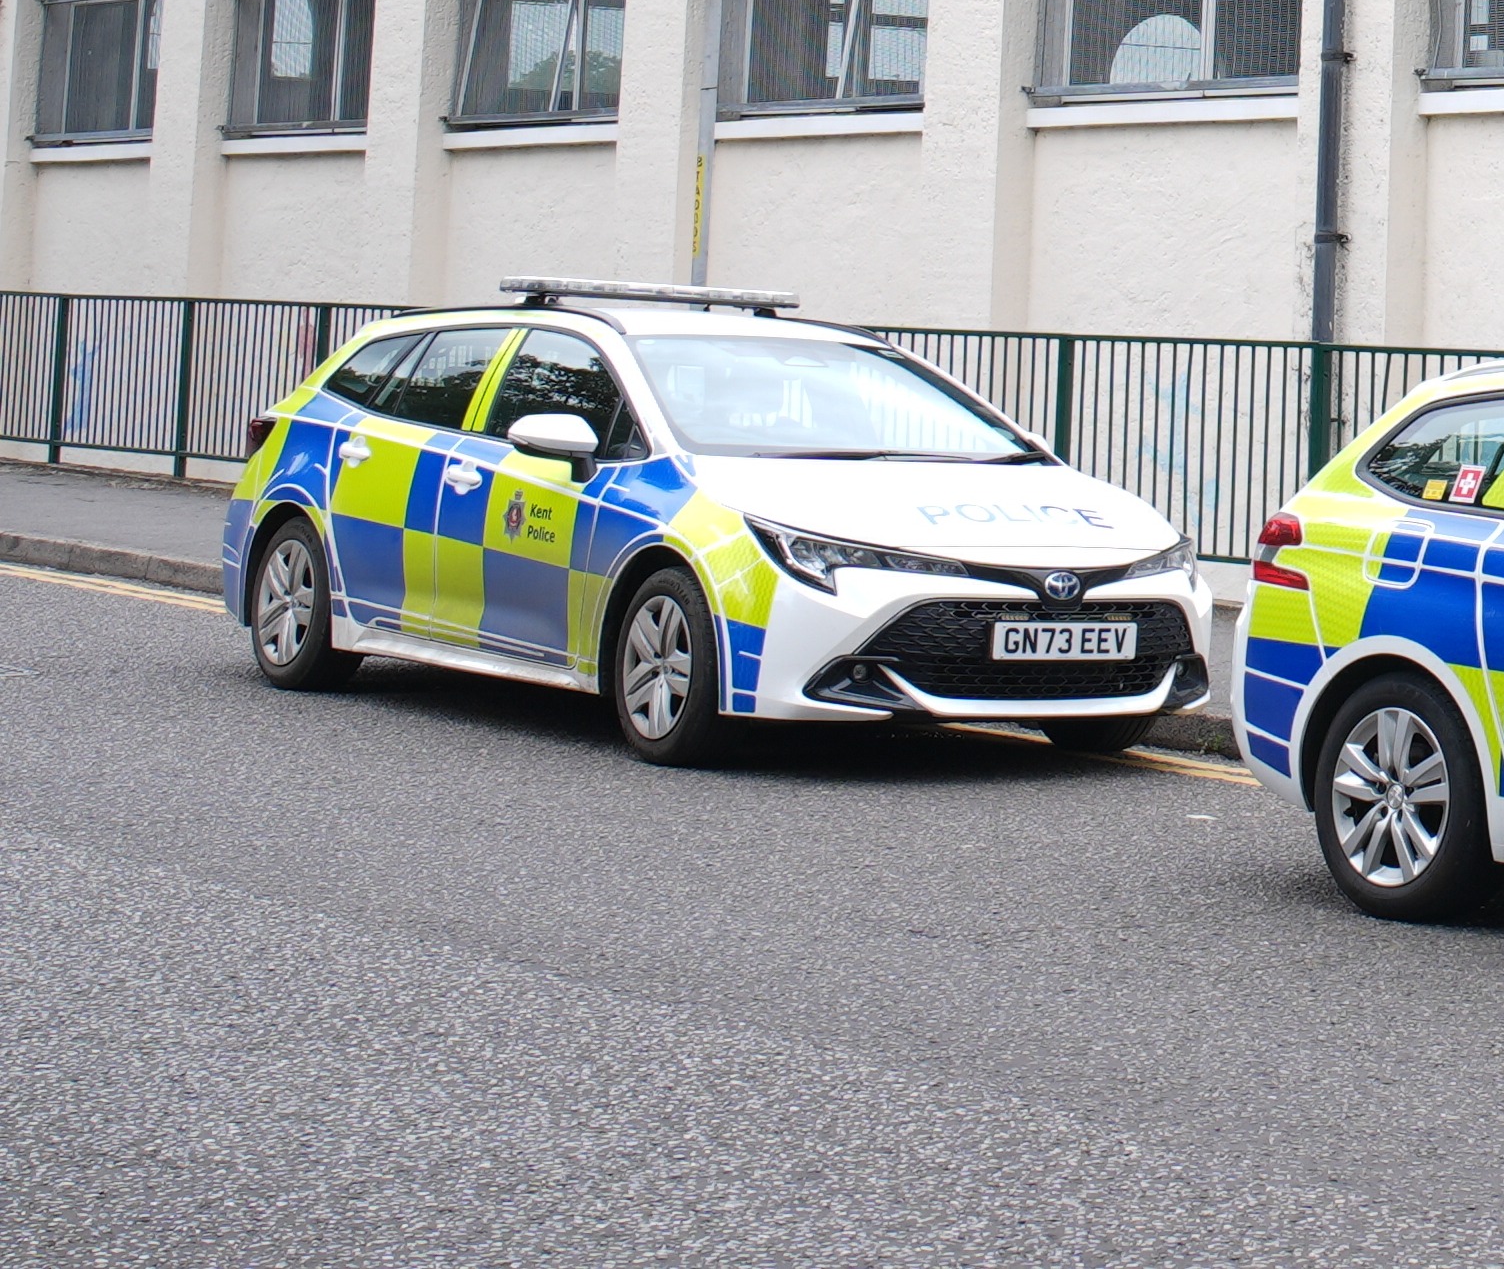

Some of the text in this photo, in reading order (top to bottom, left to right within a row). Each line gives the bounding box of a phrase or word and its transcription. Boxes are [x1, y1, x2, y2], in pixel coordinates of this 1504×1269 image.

[530, 503, 553, 520] Kent
[916, 504, 1115, 529] POLICE
[527, 525, 556, 543] Police
[1004, 627, 1127, 655] GN73 EEV
